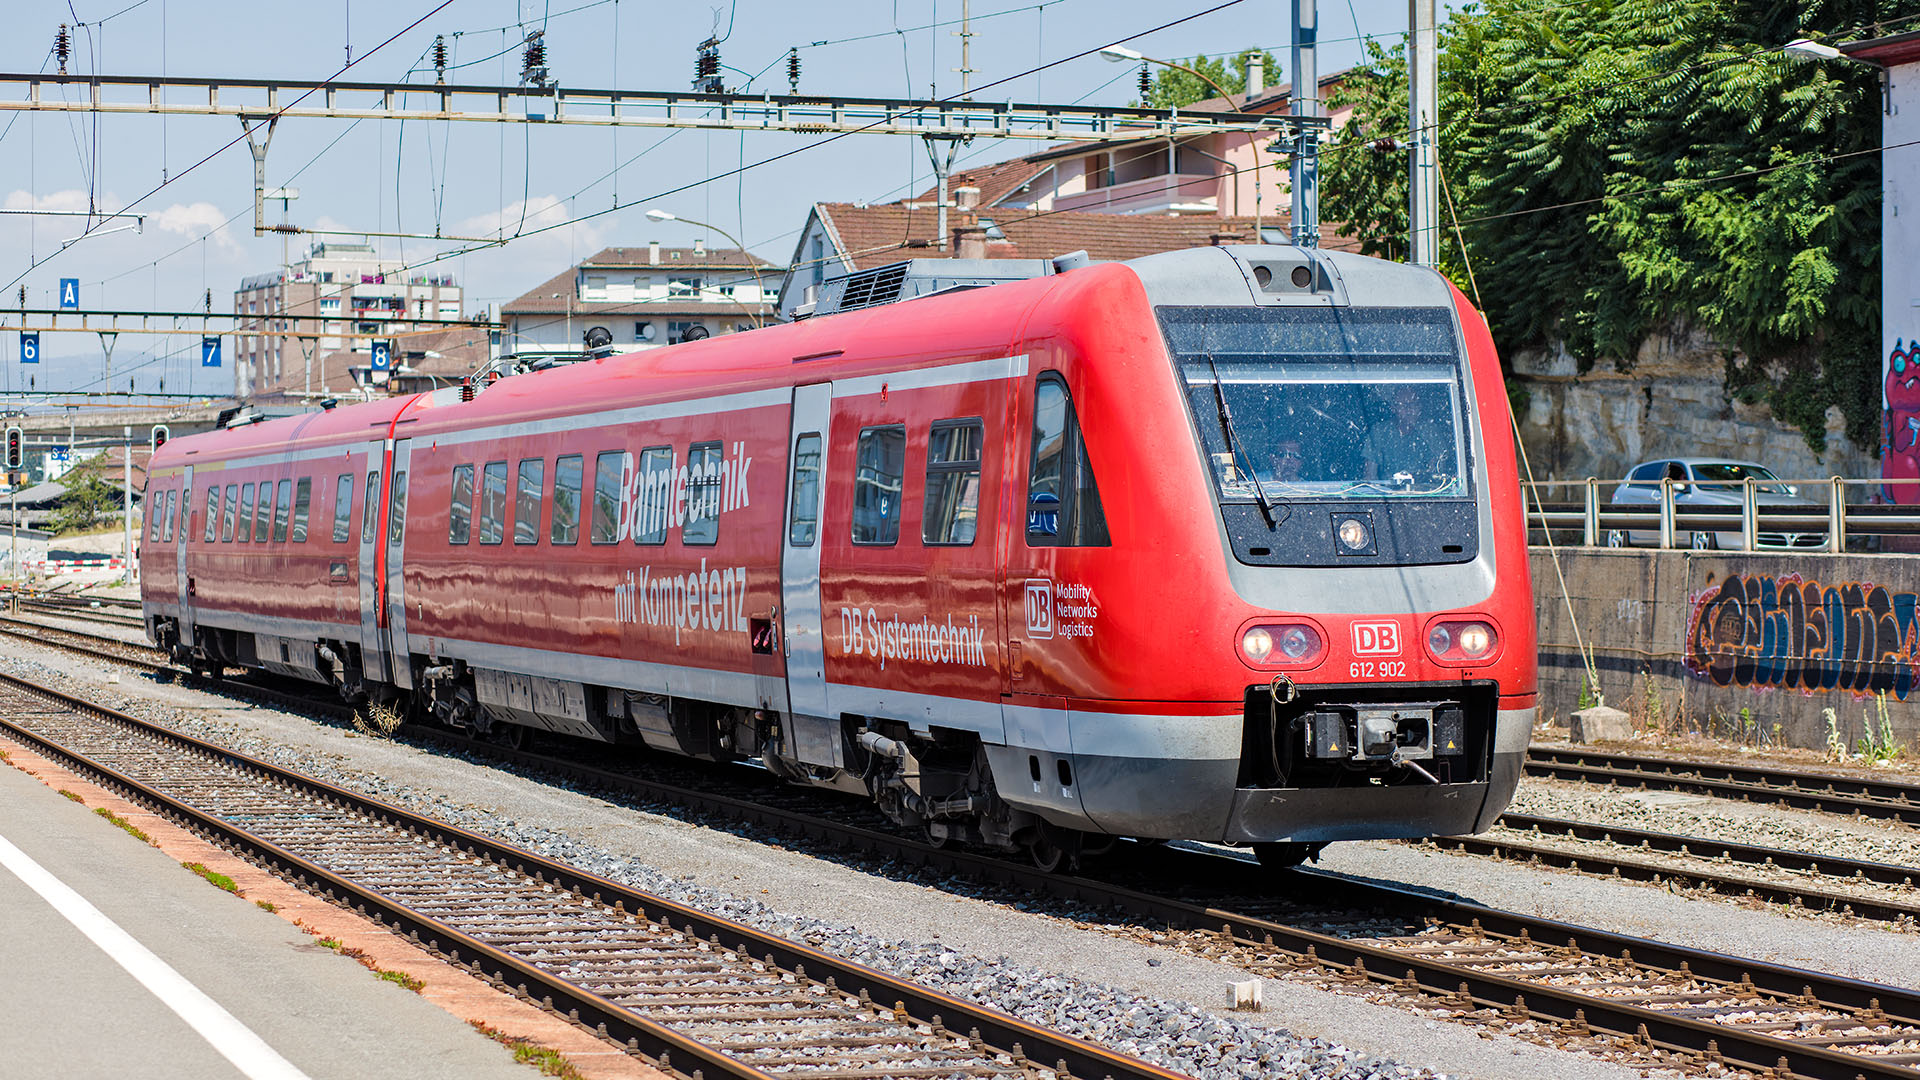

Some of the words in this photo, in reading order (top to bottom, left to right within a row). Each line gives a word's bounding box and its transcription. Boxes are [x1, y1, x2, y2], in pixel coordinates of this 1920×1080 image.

[64, 282, 75, 304] A
[24, 338, 36, 359] 6
[207, 342, 217, 363] 7
[375, 346, 387, 367] 8
[618, 441, 753, 542] Bahntechnik
[614, 569, 637, 624] mit
[639, 557, 748, 646] Kompetenz
[1056, 583, 1092, 602] Mobility
[1028, 589, 1049, 628] DB
[1057, 602, 1098, 618] Networks
[841, 607, 864, 655] DB
[867, 607, 986, 671] Systemtechnik
[1057, 621, 1094, 640] Logistics
[1357, 626, 1396, 651] DB
[1350, 662, 1375, 678] 612
[1379, 661, 1406, 677] 902
